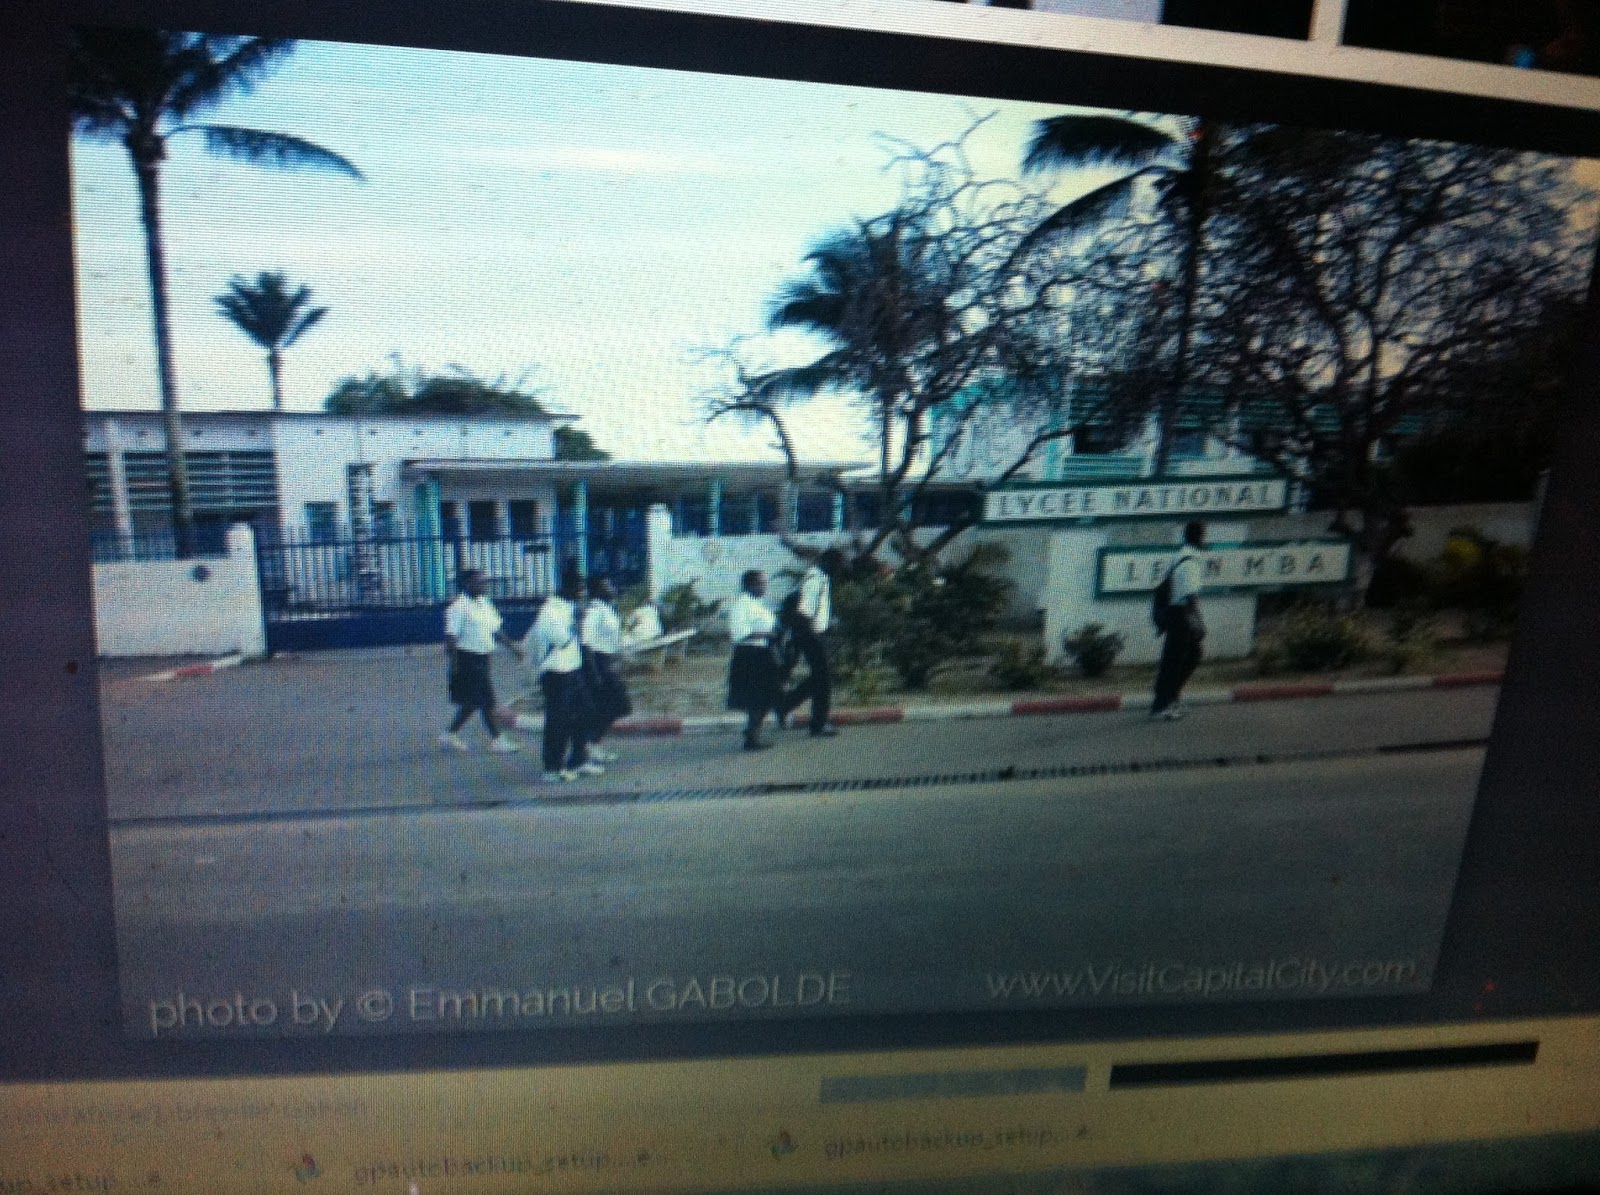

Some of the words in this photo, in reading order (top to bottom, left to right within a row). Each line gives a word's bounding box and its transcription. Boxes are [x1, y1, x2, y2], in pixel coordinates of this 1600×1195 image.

[998, 489, 1097, 517] LYCEE
[1113, 484, 1271, 511] NATIONAL
[1124, 556, 1222, 584] LEN
[1245, 553, 1325, 577] MBA
